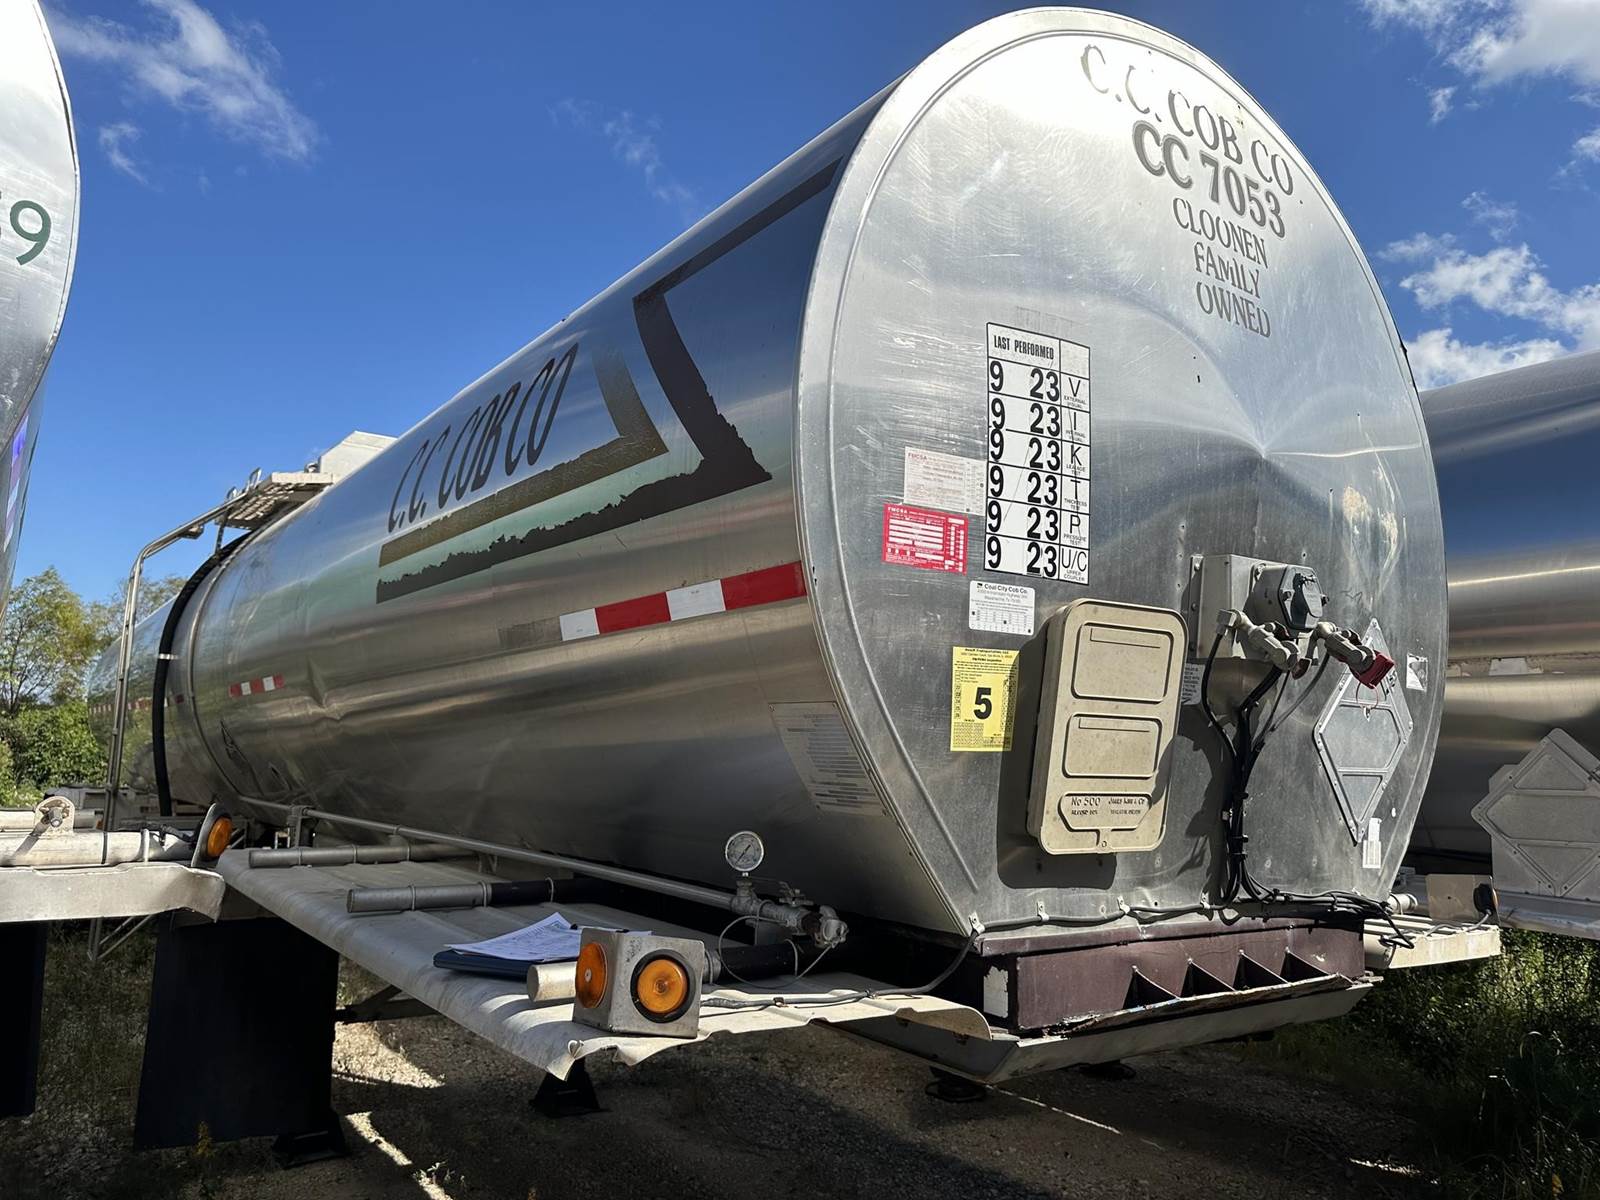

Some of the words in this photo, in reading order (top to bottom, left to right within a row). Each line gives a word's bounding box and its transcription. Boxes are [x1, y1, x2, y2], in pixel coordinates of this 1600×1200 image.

[1168, 89, 1243, 165] COB
[1251, 140, 1294, 195] CO
[1132, 120, 1193, 190] CC
[1200, 150, 1286, 238] 7053
[0, 191, 52, 266] 9
[1173, 197, 1268, 269] CLOONEN
[1194, 241, 1260, 299] FAMILY
[1196, 281, 1271, 338] OWNED
[993, 334, 1010, 351] LAST
[1014, 340, 1055, 360] PERFORMED
[990, 360, 1004, 392] 9
[1030, 368, 1060, 402] 23
[1068, 377, 1081, 397] V
[438, 381, 521, 509] COB
[505, 342, 579, 477] CO
[991, 398, 1006, 430] 9
[1030, 403, 1060, 437] 23
[990, 429, 1004, 460] 9
[1029, 437, 1060, 471] 23
[1071, 444, 1082, 466] K
[989, 465, 1004, 497] 9
[1027, 472, 1058, 506] 23
[1070, 479, 1081, 500] T
[988, 500, 1002, 533] 9
[1027, 507, 1059, 541] 23
[1070, 514, 1081, 534] P
[987, 536, 1001, 569] 9
[1026, 542, 1057, 578] 23
[1061, 547, 1087, 572] U/C
[973, 687, 993, 720] 5
